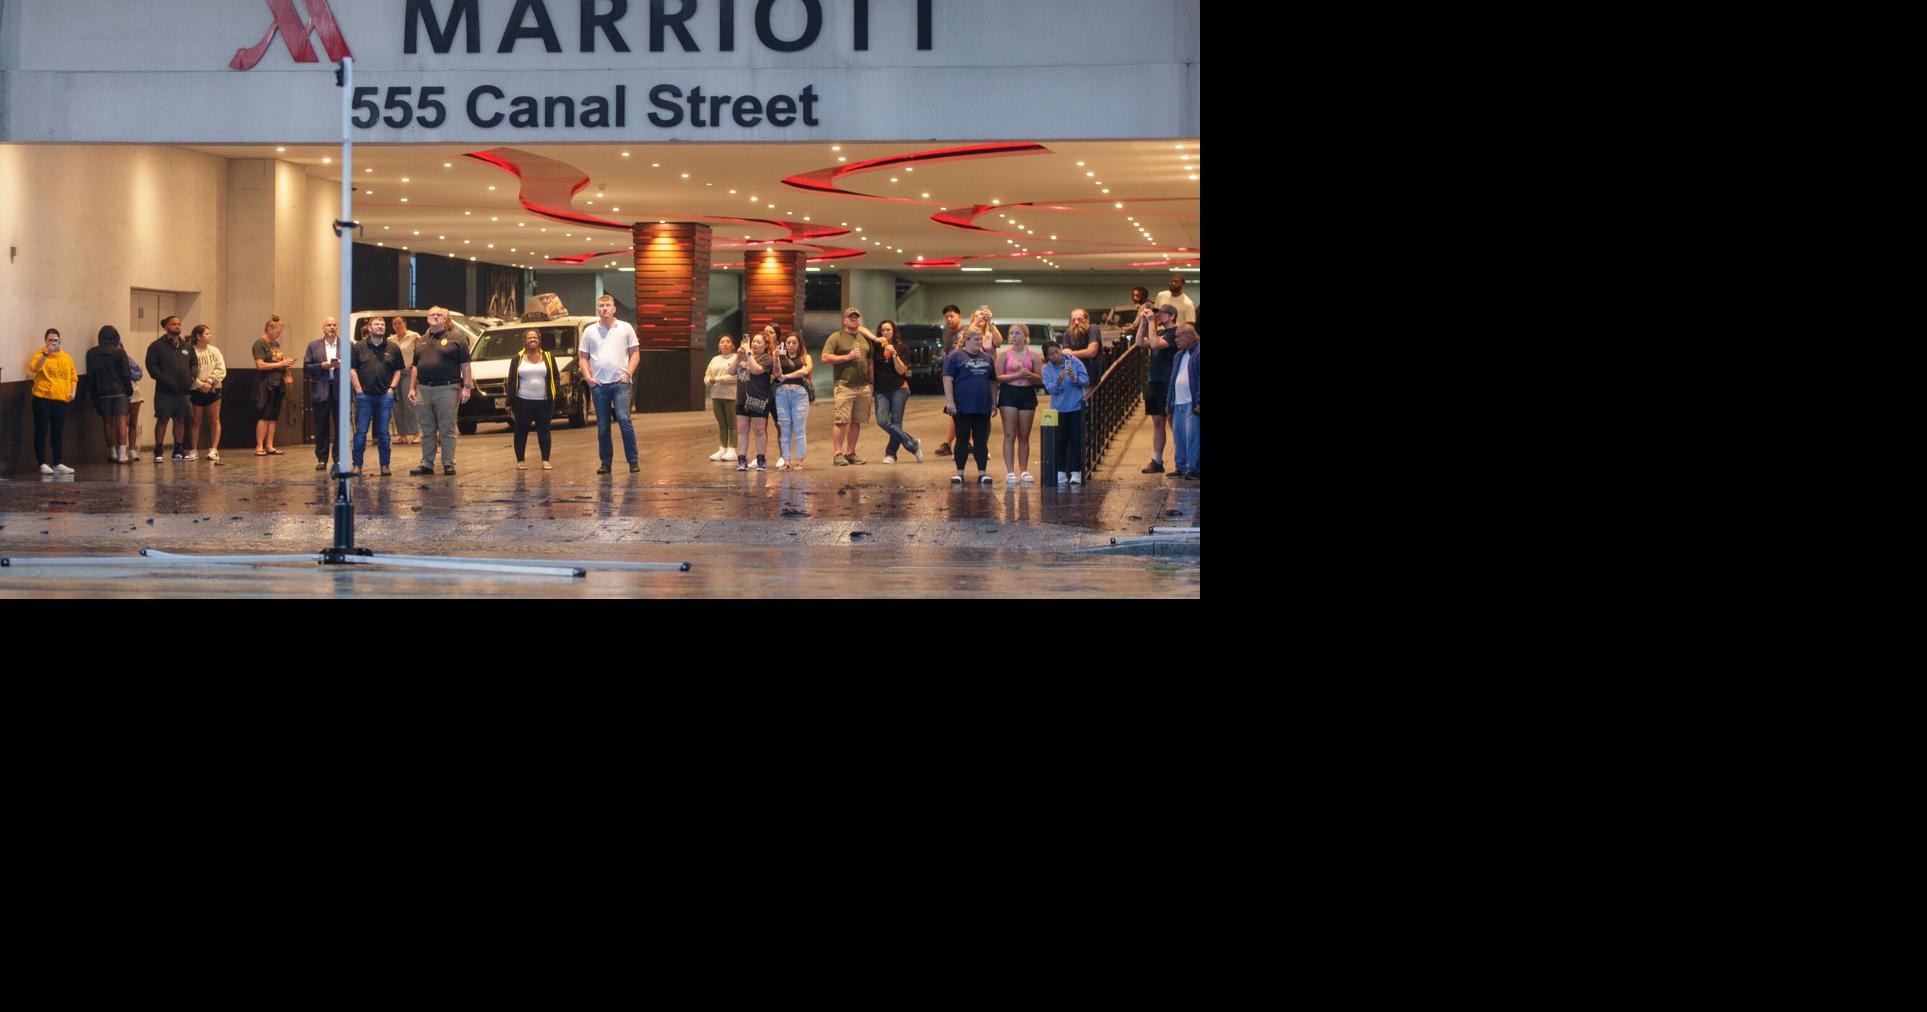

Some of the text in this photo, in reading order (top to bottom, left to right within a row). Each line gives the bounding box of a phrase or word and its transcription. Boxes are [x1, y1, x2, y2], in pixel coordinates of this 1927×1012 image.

[351, 84, 819, 128] 555 Canal Street
